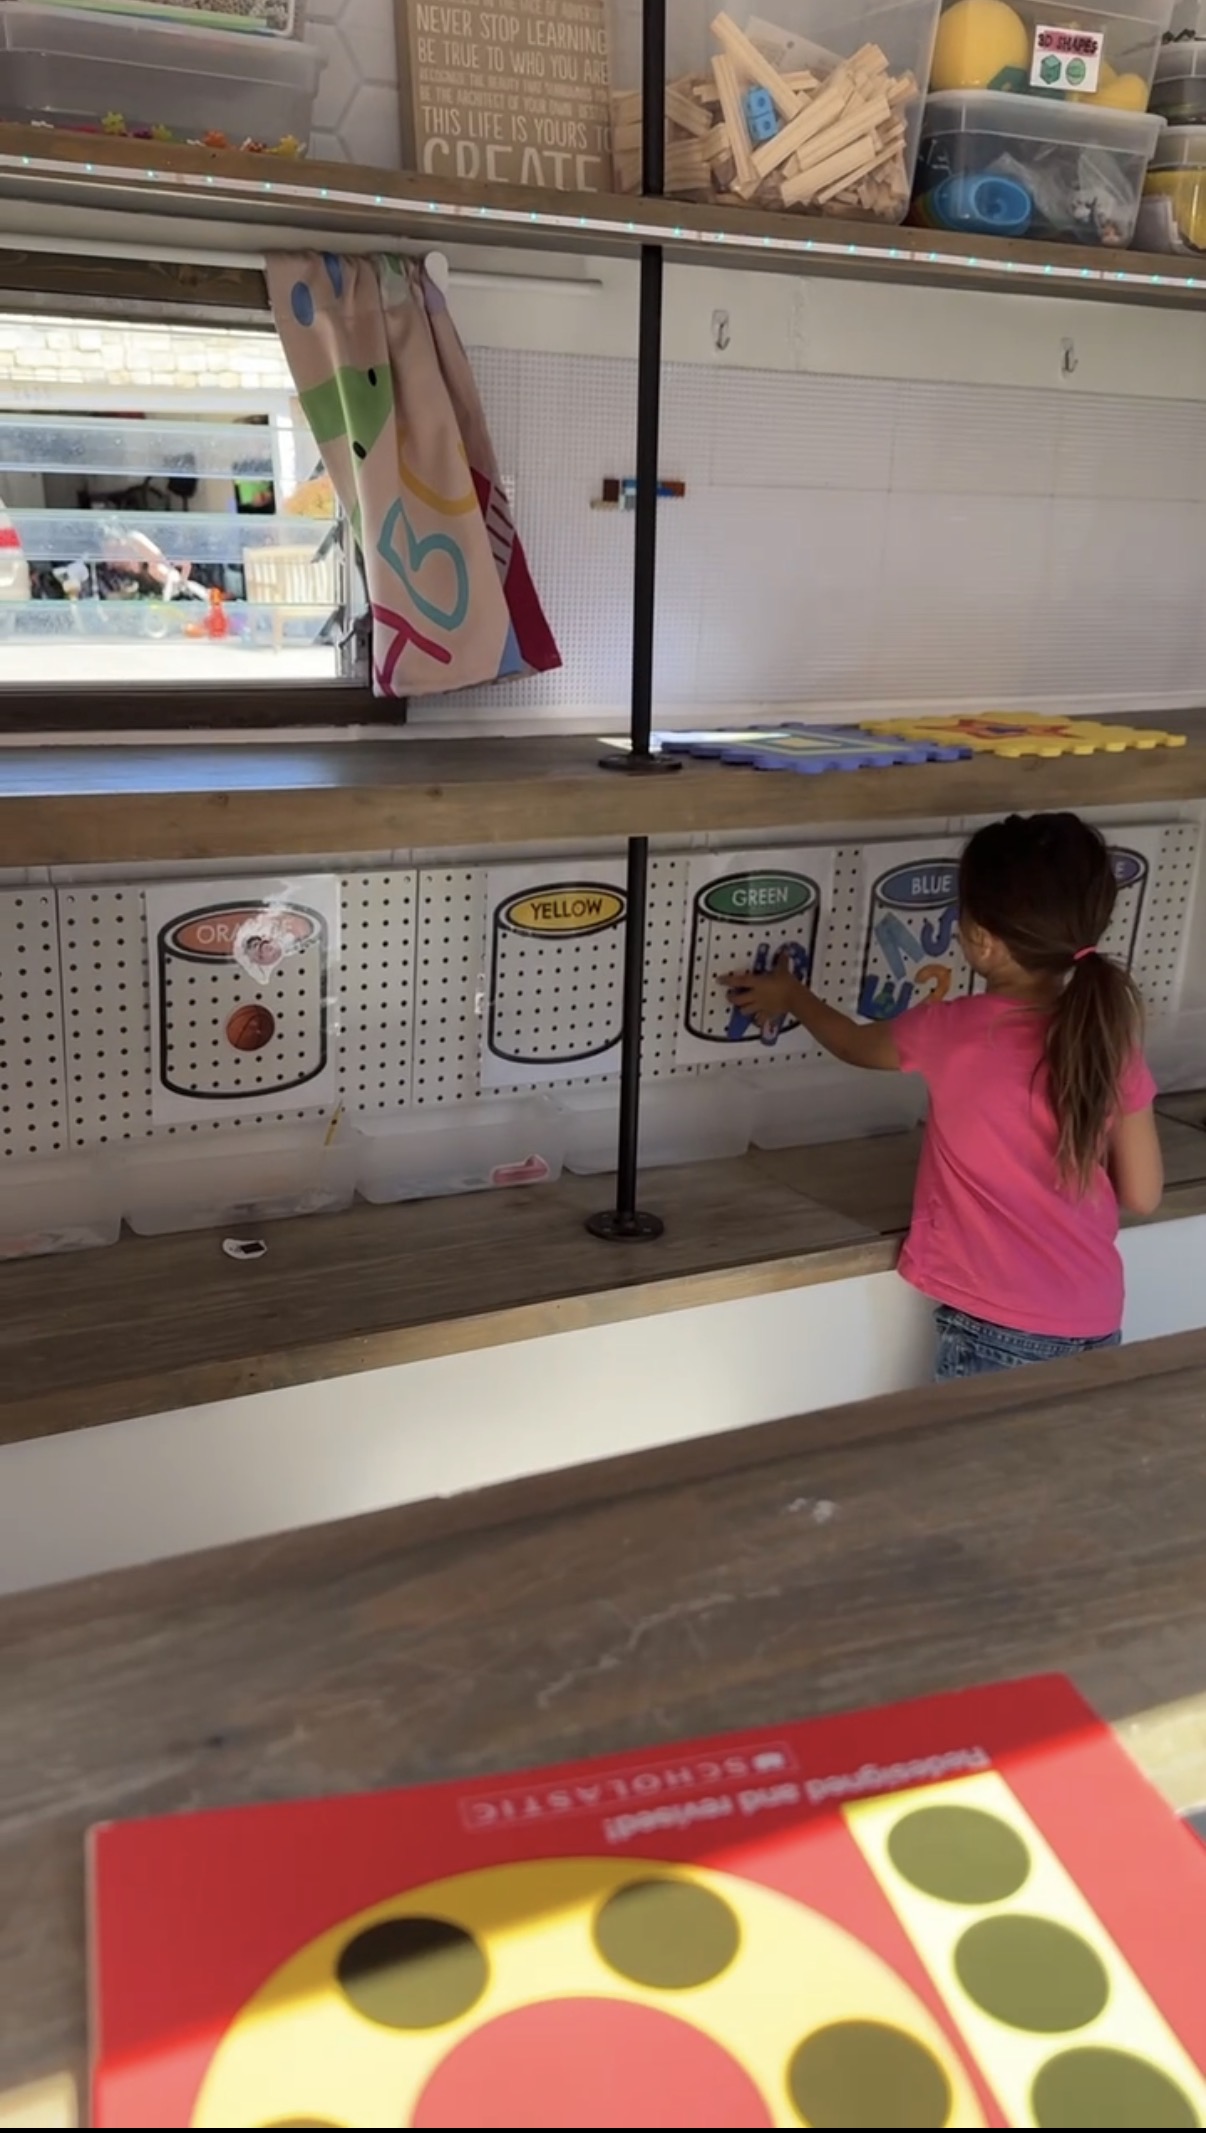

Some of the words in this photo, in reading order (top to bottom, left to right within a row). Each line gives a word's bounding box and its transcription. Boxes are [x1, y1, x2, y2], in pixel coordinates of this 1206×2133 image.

[416, 4, 472, 37] NEVER
[480, 12, 520, 43] STOP
[527, 18, 607, 55] LEARNING
[1038, 33, 1053, 47] 3D
[1057, 35, 1098, 54] SHAPES
[418, 37, 436, 63] BE
[442, 40, 479, 69] TRUE
[486, 46, 504, 72] TO
[509, 49, 545, 77] WHO
[550, 53, 577, 81] YOU
[583, 59, 608, 85] ARE
[436, 87, 452, 103] THE
[421, 105, 461, 136] THIS
[469, 110, 504, 140] LIFE
[512, 115, 528, 142] IS
[534, 117, 587, 149] YOURS
[593, 126, 610, 152] TO
[424, 137, 601, 193] CREATE
[732, 887, 788, 907] GREEN
[911, 875, 953, 895] BLUE
[530, 898, 603, 920] YELLOW
[470, 1756, 747, 1824] SCHOLASTIC
[807, 1746, 991, 1802] Redesigned
[603, 1796, 733, 1844] revised!
[738, 1782, 799, 1816] and
